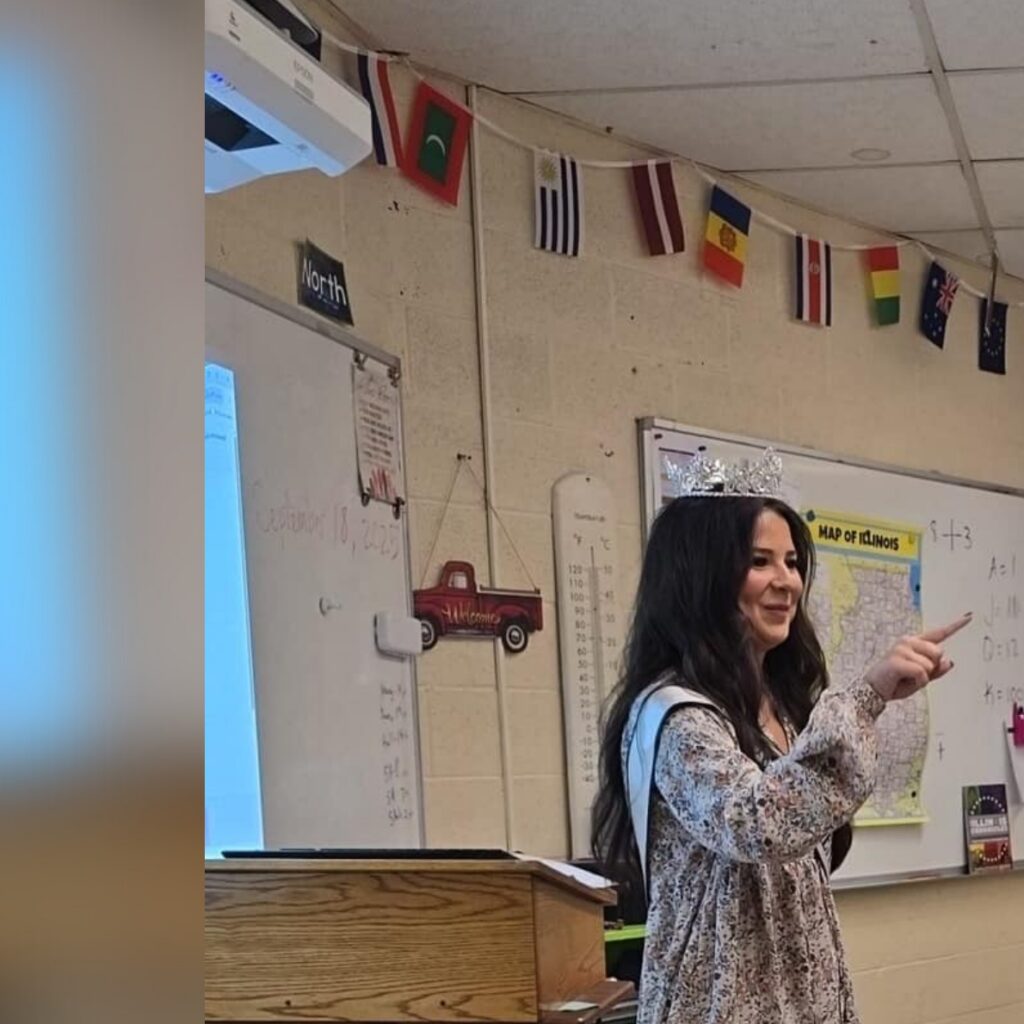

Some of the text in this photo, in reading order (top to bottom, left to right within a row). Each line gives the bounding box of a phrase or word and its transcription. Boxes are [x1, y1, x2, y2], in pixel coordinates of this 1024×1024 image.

[302, 256, 347, 306] North
[818, 524, 900, 551] MAP OF ILLINOIS
[441, 602, 501, 626] Welcome
